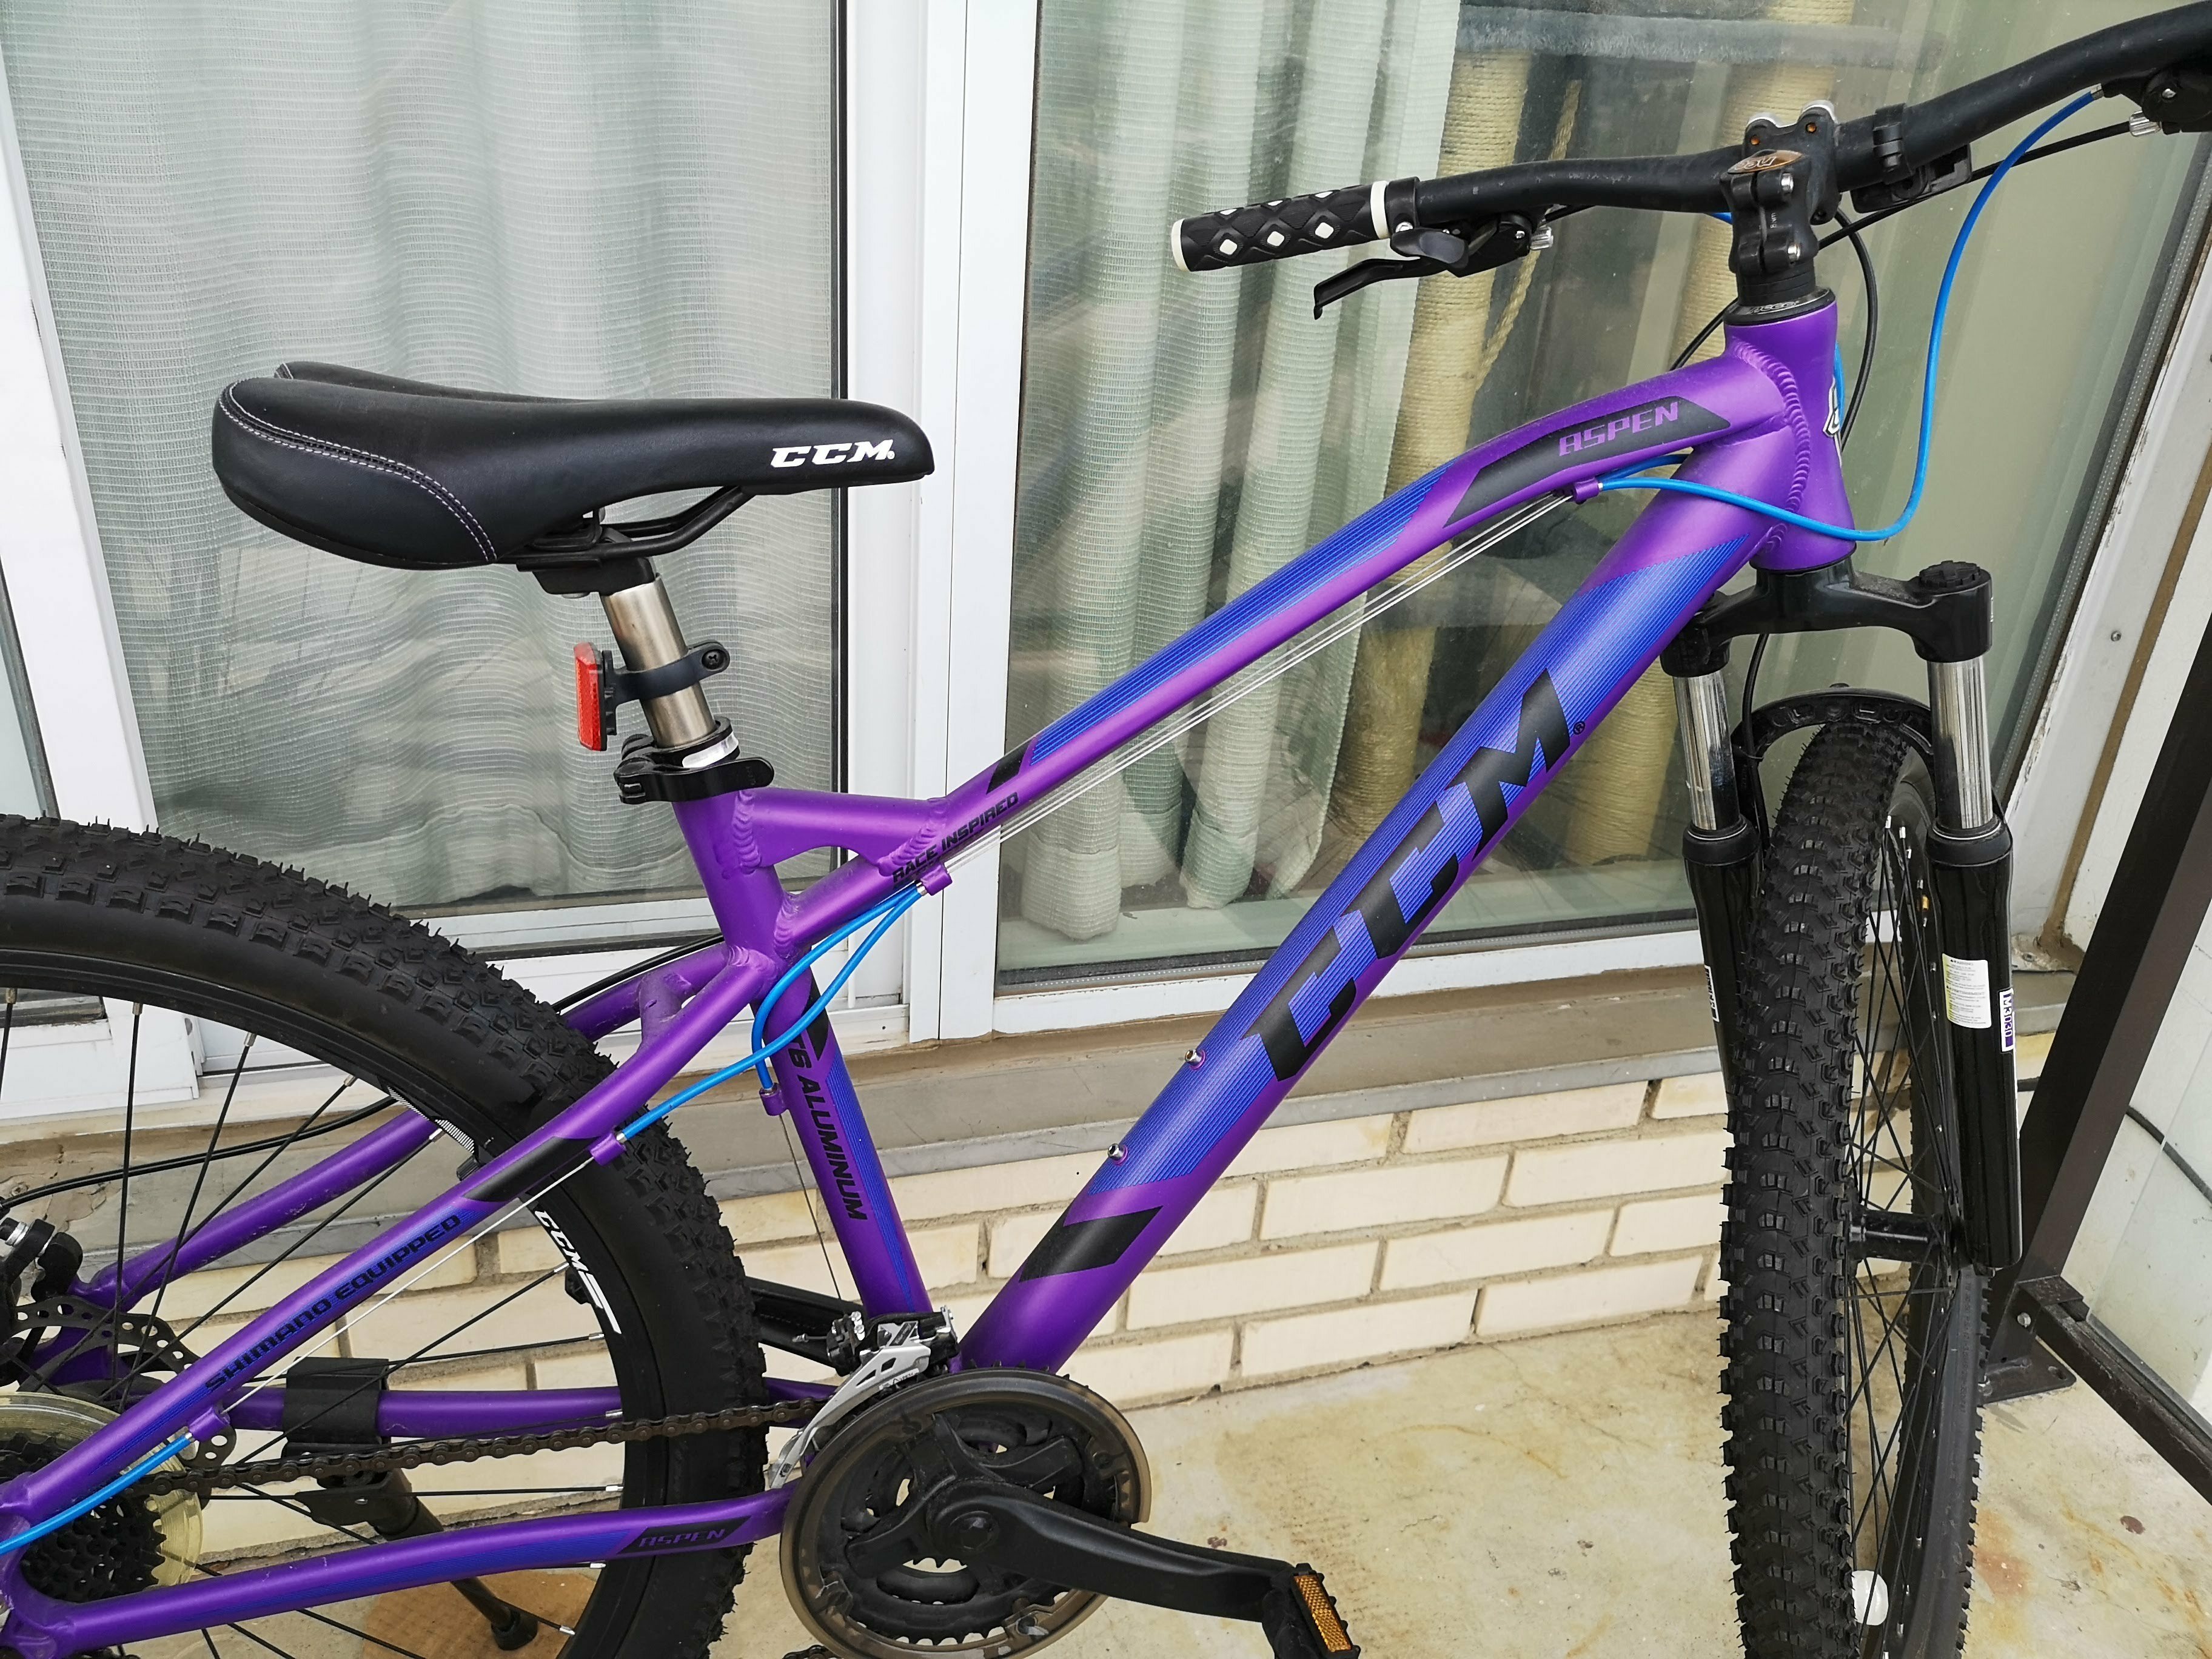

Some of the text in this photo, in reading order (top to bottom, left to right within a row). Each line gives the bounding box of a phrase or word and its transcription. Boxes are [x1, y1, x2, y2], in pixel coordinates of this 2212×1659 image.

[770, 439, 894, 468] CCM
[1558, 401, 1678, 457] ASPEN
[892, 791, 1019, 883] RACE INSPIRED
[1241, 668, 1570, 1082] CCM
[797, 1074, 868, 1221] ALUMINUM
[534, 1210, 589, 1273] CCM
[204, 1215, 461, 1389] SHIMANO EQUIPPED
[638, 1528, 726, 1547] ASPEN
